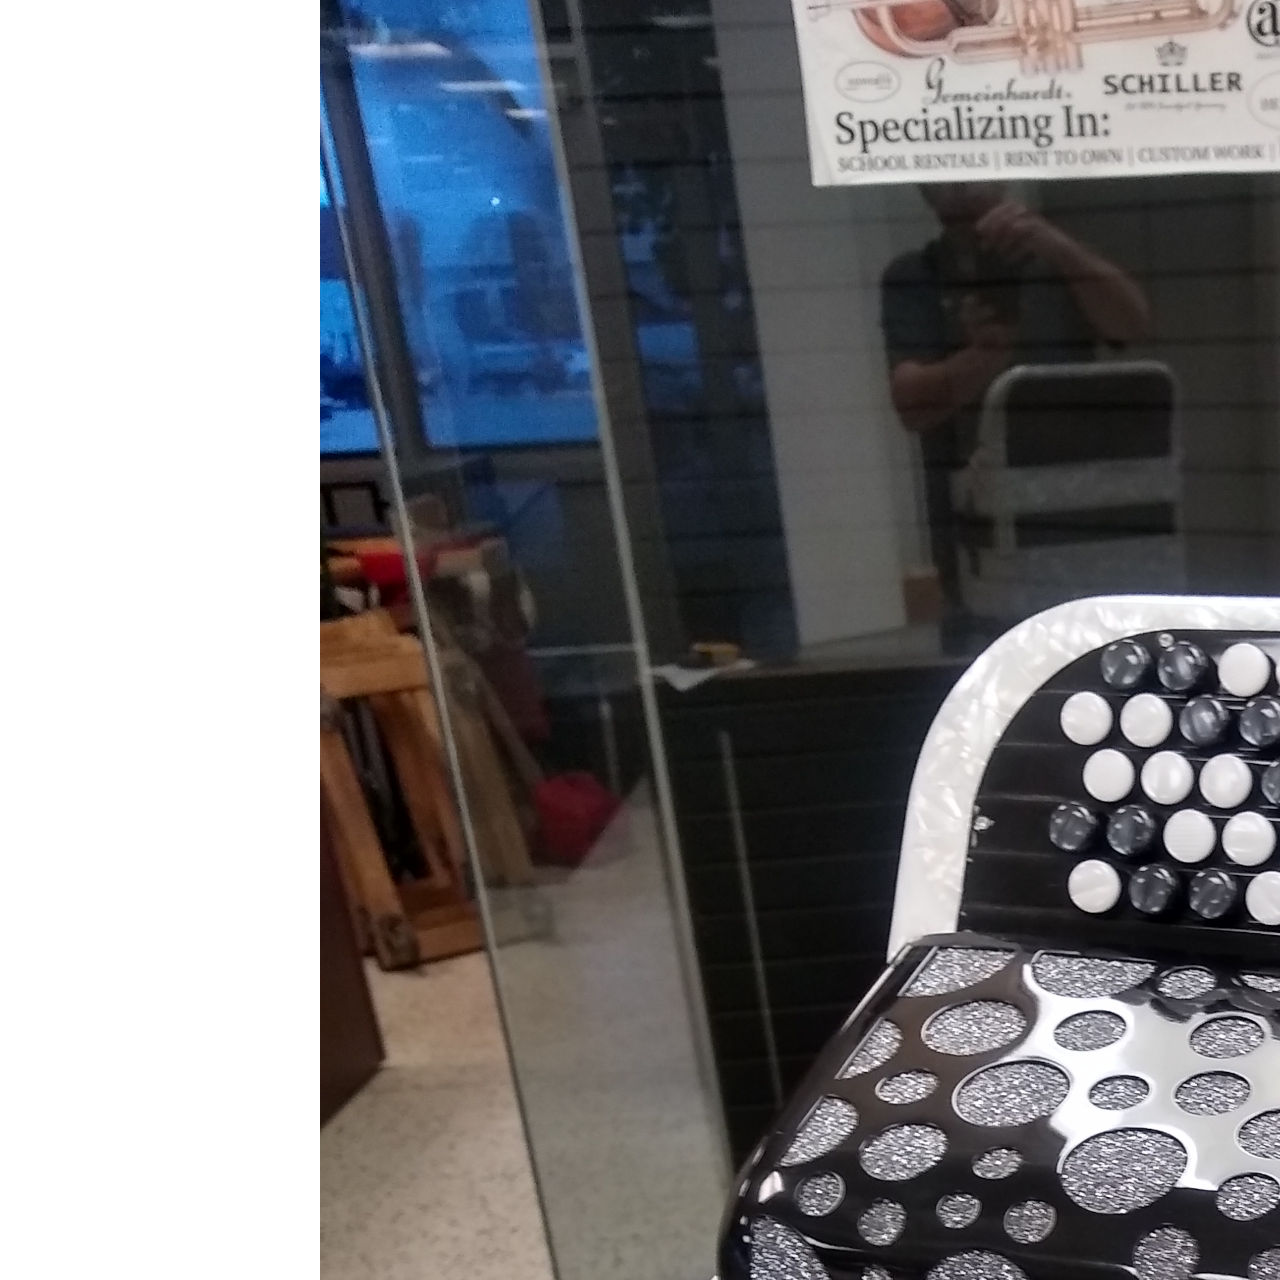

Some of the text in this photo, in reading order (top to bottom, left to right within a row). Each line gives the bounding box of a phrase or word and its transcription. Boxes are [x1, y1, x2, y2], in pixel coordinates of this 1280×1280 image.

[1103, 71, 1243, 95] SCHILLER
[835, 103, 1111, 154] Specializing In:
[837, 153, 908, 172] SCHOOL
[914, 151, 990, 170] RENTALS
[1005, 149, 1048, 168] RENT
[1053, 149, 1079, 166] TO
[1081, 148, 1123, 165] OWN
[1137, 145, 1211, 164] CUSTOM
[1211, 143, 1264, 161] WORK
